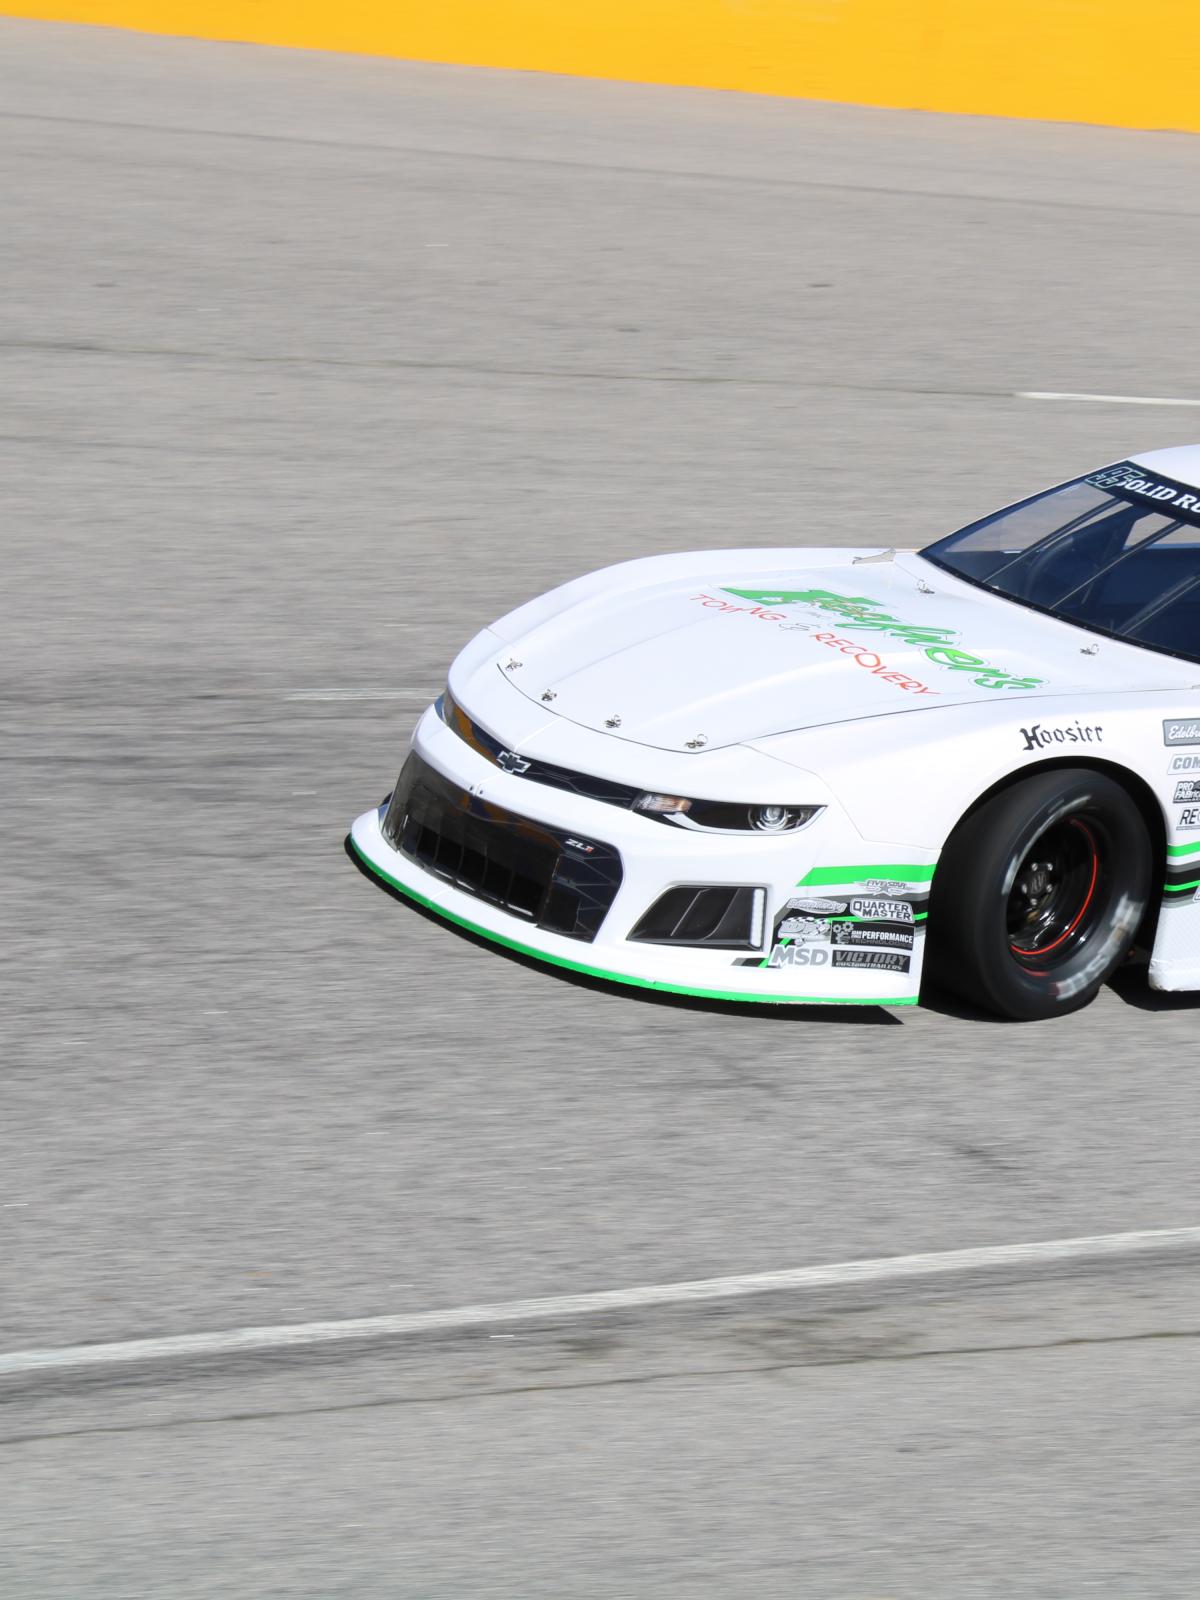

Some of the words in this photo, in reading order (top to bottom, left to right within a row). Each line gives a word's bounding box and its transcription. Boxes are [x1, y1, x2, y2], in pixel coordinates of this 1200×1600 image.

[690, 594, 787, 621] TOWNG
[809, 632, 942, 695] RECOVERY
[1019, 720, 1103, 751] Hoosier
[1177, 781, 1194, 791] PRO
[853, 900, 910, 912] QUARTER
[862, 908, 911, 920] MASTER
[862, 931, 914, 944] PERFORMANCE
[771, 946, 829, 967] MSD
[835, 951, 910, 967] VICTORY
